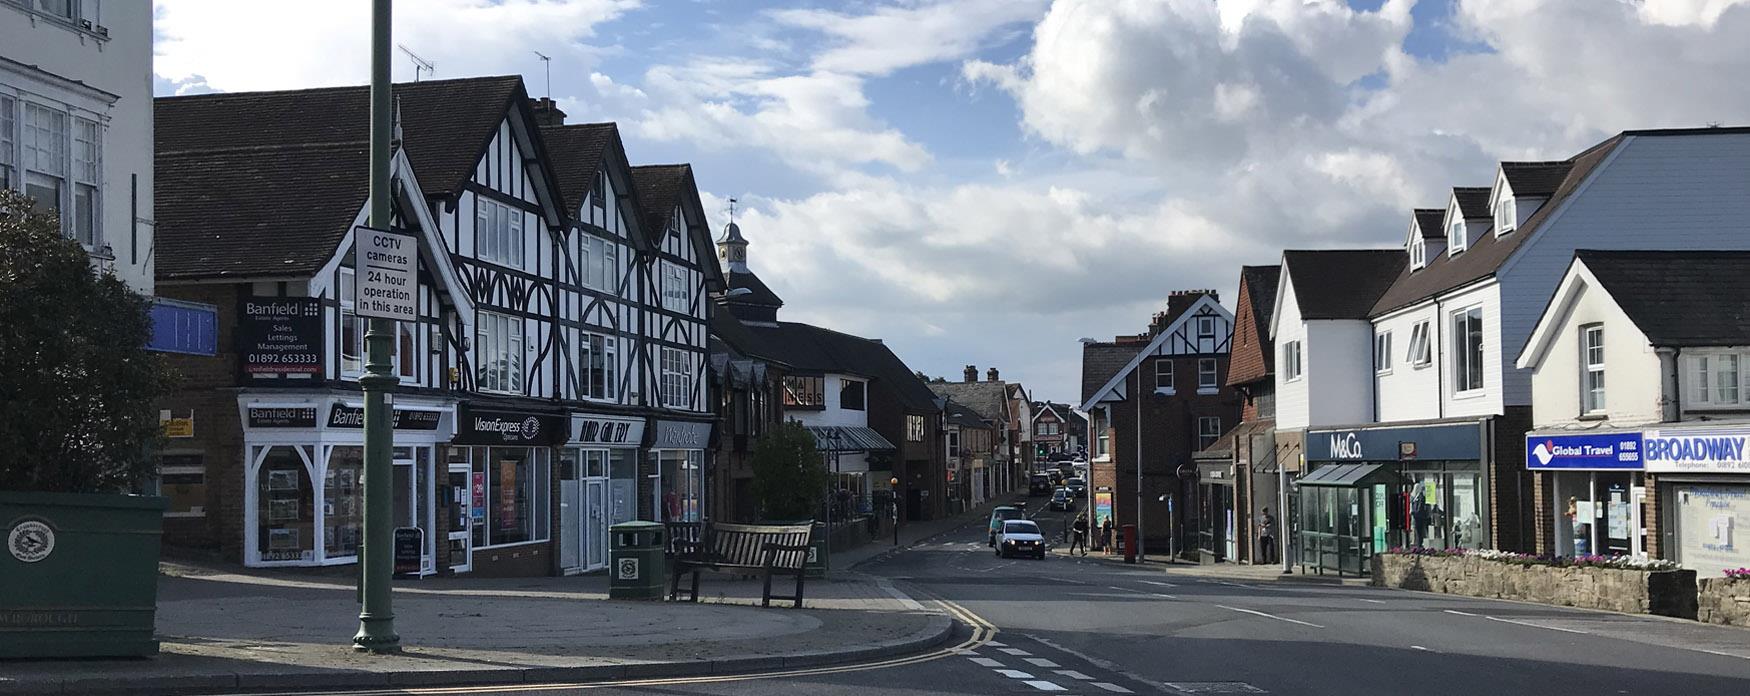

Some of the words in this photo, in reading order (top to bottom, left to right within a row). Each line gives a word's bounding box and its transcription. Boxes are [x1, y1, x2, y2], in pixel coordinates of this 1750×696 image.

[373, 235, 402, 249] CCTV
[367, 251, 408, 265] cameras
[367, 270, 382, 282] 24
[385, 273, 407, 286] hour
[364, 287, 410, 301] operation
[246, 302, 298, 315] Banfield
[359, 298, 369, 310] in
[372, 300, 391, 313] this
[393, 306, 414, 315] area
[272, 324, 293, 332] Sales
[267, 334, 298, 343] Lettings
[257, 343, 308, 352] Management
[248, 353, 279, 363] 01892
[281, 353, 318, 363] 653333
[250, 408, 296, 418] Banfield
[333, 407, 364, 425] Banfie
[1330, 432, 1363, 458] M&Co.
[1552, 445, 1582, 456] Global
[1585, 445, 1613, 455] Travel
[1645, 437, 1746, 461] BROADWAY
